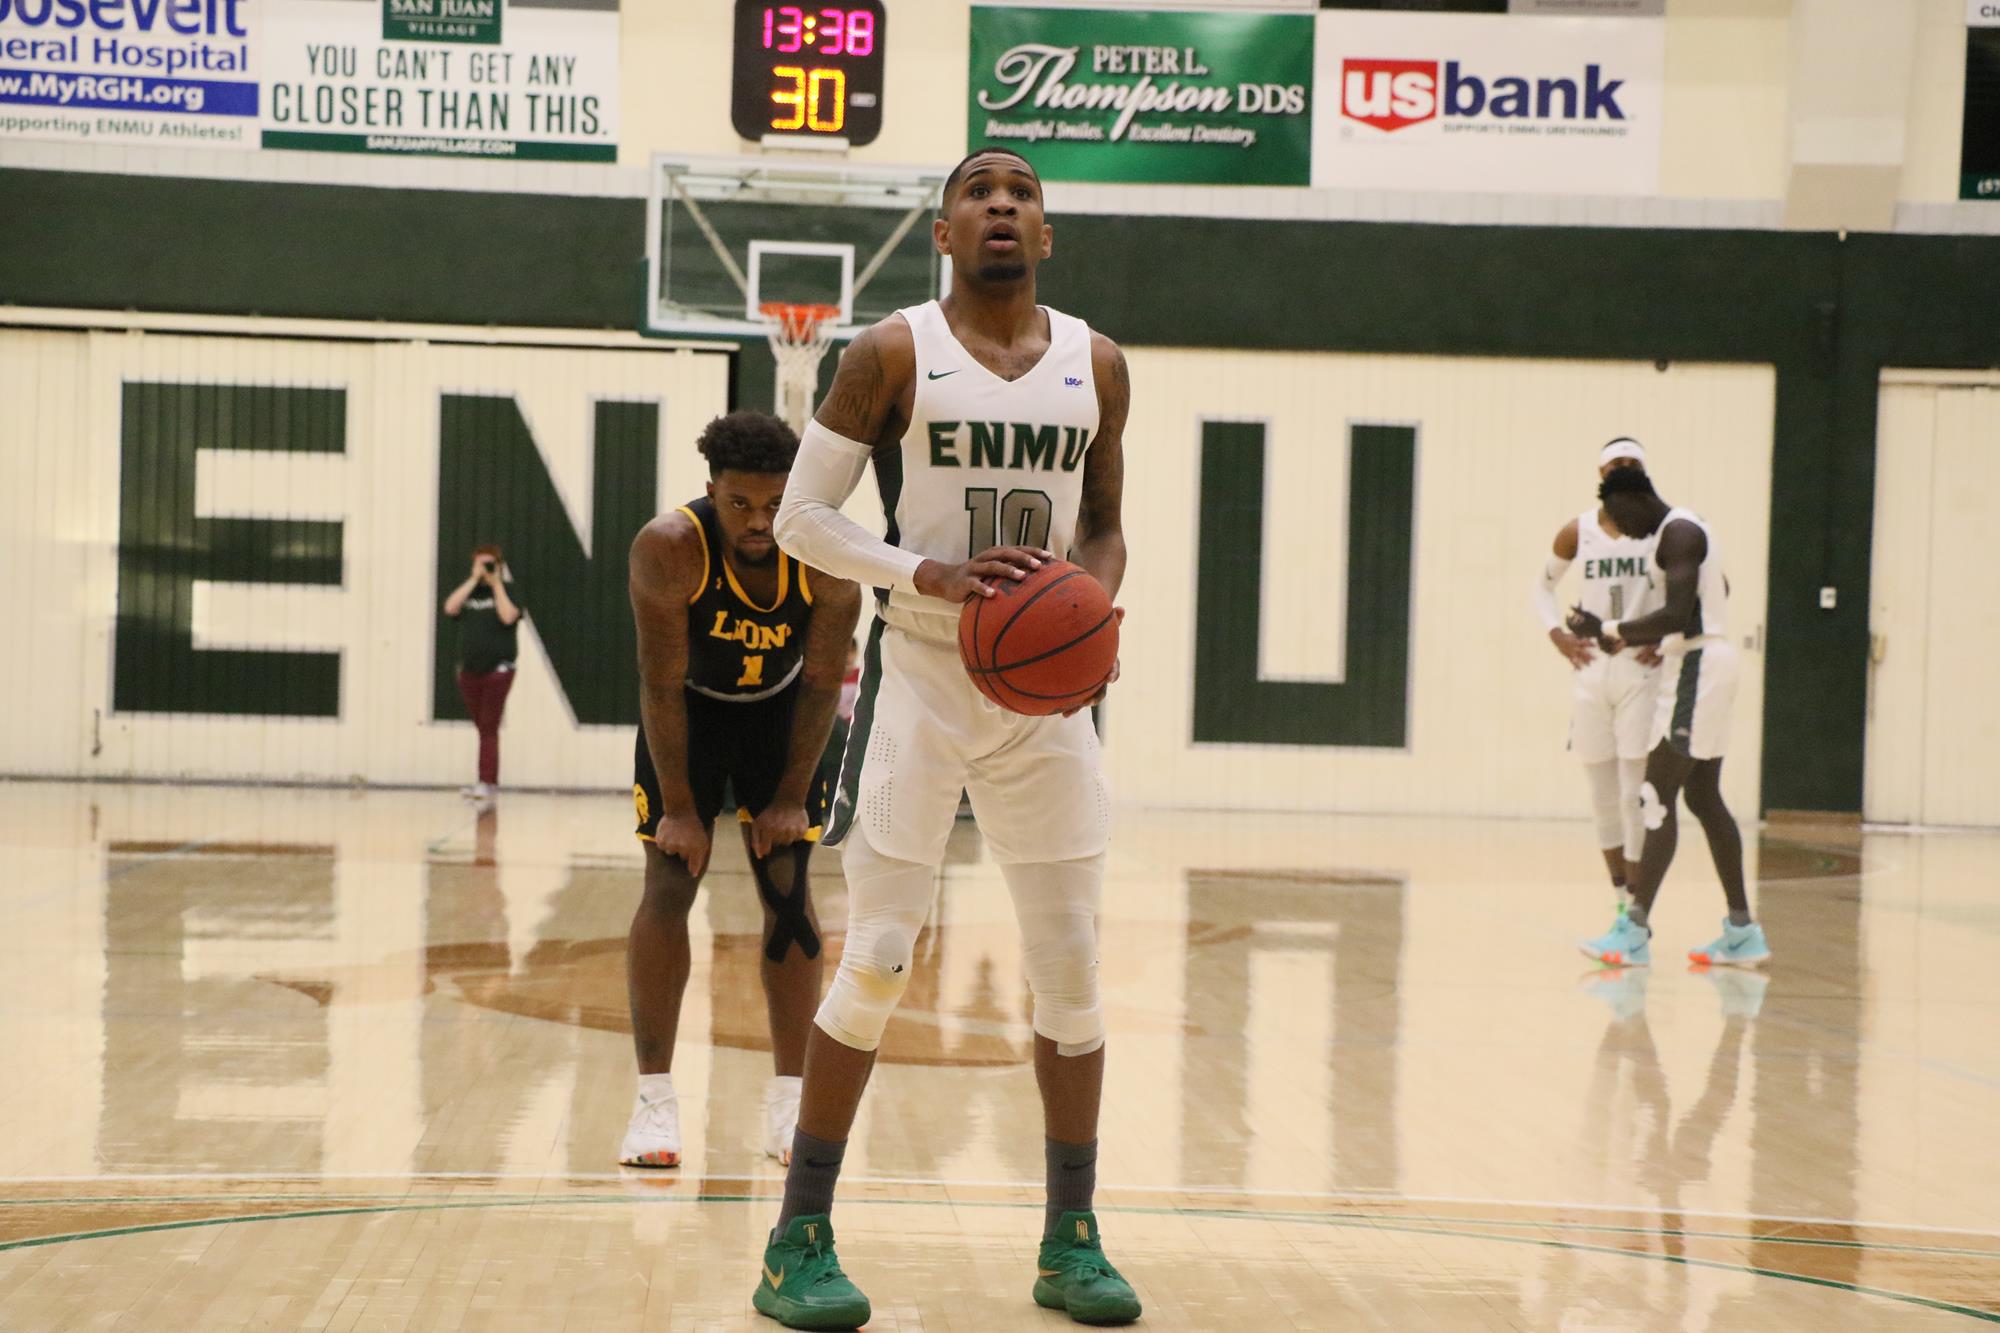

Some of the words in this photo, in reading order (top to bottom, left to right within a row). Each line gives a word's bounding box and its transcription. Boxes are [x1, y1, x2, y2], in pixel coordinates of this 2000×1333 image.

[391, 0, 434, 14] SAN
[441, 0, 494, 17] JUAN
[407, 22, 476, 36] VILLAGE
[762, 6, 874, 56] 13:38
[0, 36, 77, 63] eral
[94, 38, 247, 75] Hospital
[306, 45, 356, 77] YOU
[376, 48, 451, 82] CAN'T
[469, 53, 513, 84] GET
[528, 55, 577, 87] ANY
[1092, 45, 1178, 74] PETER
[1184, 48, 1209, 76] L.
[272, 83, 402, 128] CLOSER
[418, 89, 509, 132] THAN
[525, 94, 608, 136] THIS.
[771, 66, 845, 131] 30
[977, 43, 1233, 142] Thompson
[1237, 83, 1305, 115] DDS
[96, 118, 153, 137] ENMU
[158, 122, 242, 141] Athletes!
[927, 421, 1089, 473] ENMU
[965, 487, 1052, 560] 10
[1609, 585, 1624, 620] 1
[736, 655, 764, 686] 1
